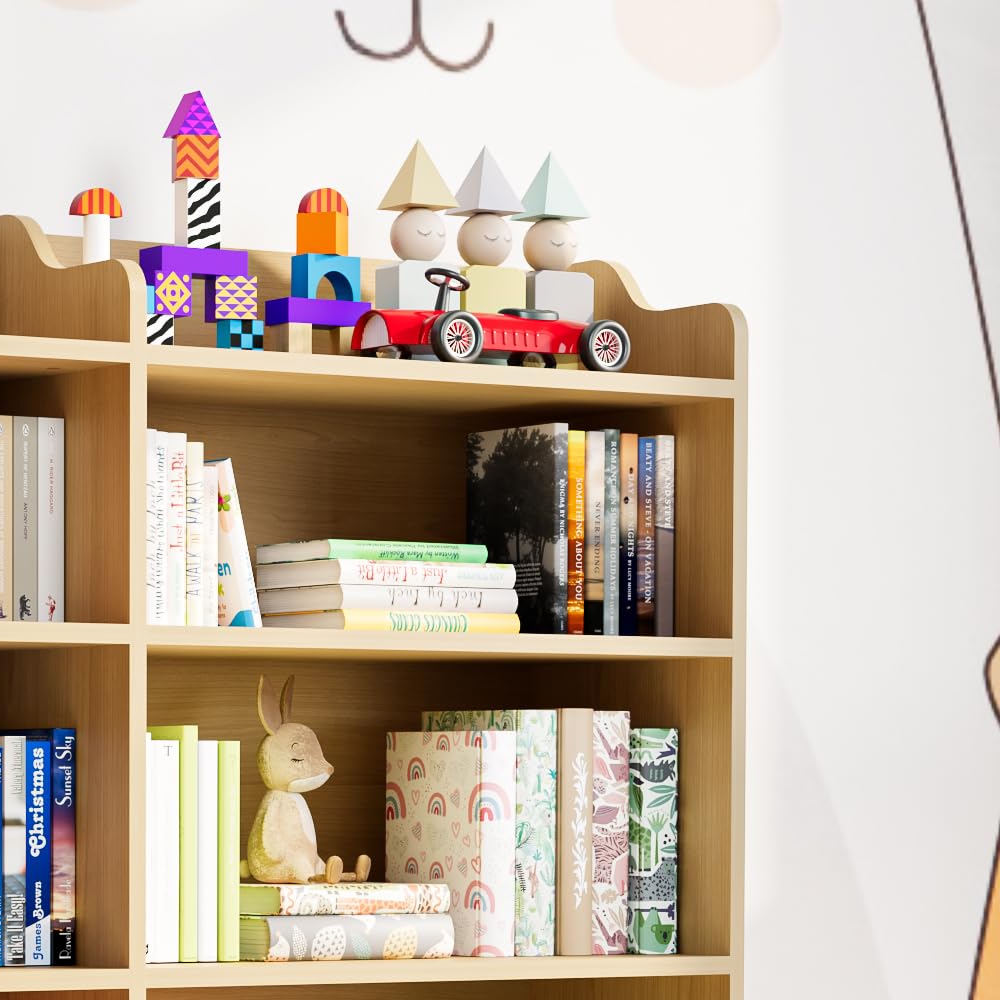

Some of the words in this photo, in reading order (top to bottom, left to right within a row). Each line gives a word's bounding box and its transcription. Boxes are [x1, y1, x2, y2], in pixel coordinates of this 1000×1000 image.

[575, 477, 583, 538] SOMETHING
[434, 552, 460, 560] Written
[645, 536, 652, 551] ON
[575, 540, 583, 574] ABOUT
[357, 565, 374, 581] Bit
[422, 568, 448, 584] Just
[386, 588, 419, 606] Inch
[451, 590, 483, 609] Inch
[575, 578, 583, 601] YOU
[54, 736, 75, 762] Sky
[54, 765, 72, 808] Sunset
[28, 747, 46, 858] Christmas
[6, 893, 26, 922] Easy!
[33, 881, 45, 920] Brown
[6, 935, 24, 961] Take
[33, 923, 44, 960] James
[59, 926, 72, 960] Ravela
